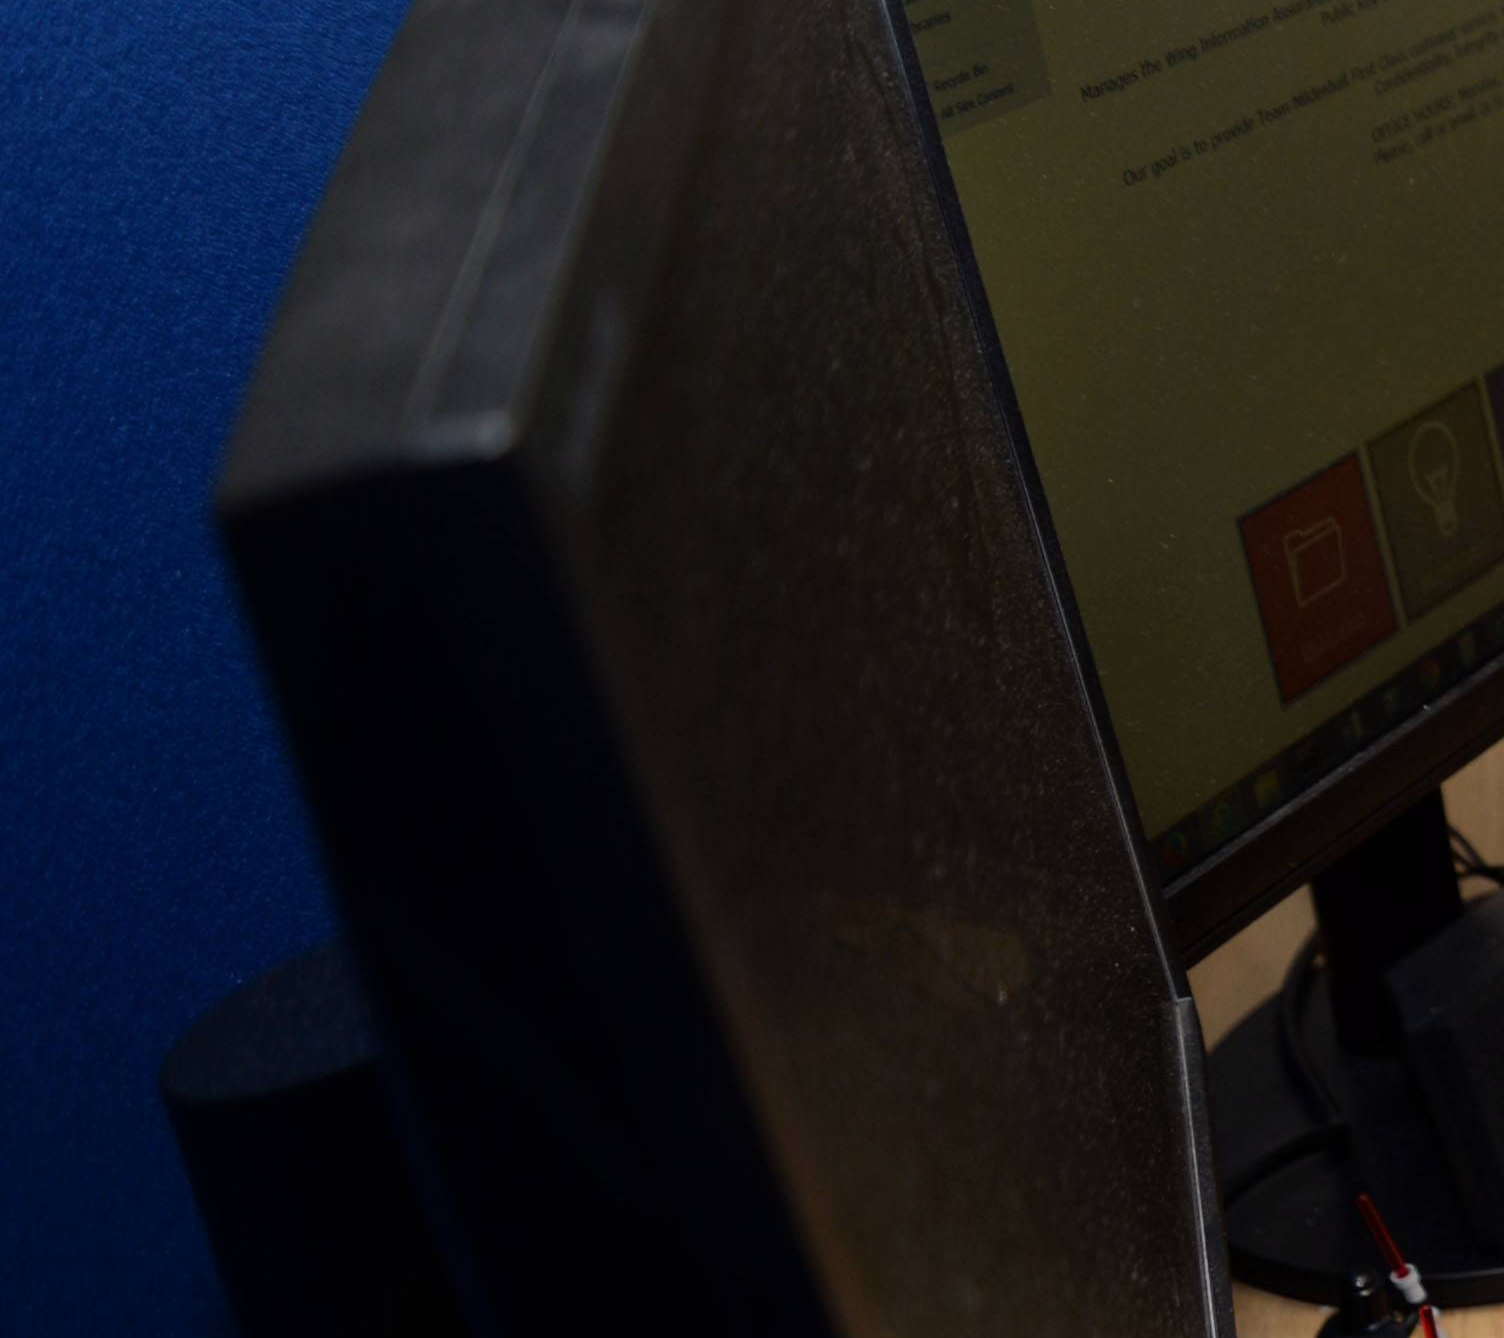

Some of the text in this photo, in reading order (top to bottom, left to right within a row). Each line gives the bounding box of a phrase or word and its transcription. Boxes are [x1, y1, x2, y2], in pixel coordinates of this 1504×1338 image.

[1079, 69, 1139, 103] Manages
[1139, 60, 1163, 78] the
[1164, 44, 1199, 68] Wing
[1198, 14, 1270, 54] Information
[1122, 165, 1148, 187] Our
[1150, 148, 1179, 178] goal
[1192, 139, 1209, 155] to
[1210, 117, 1256, 151] provide
[1256, 102, 1291, 126] Team
